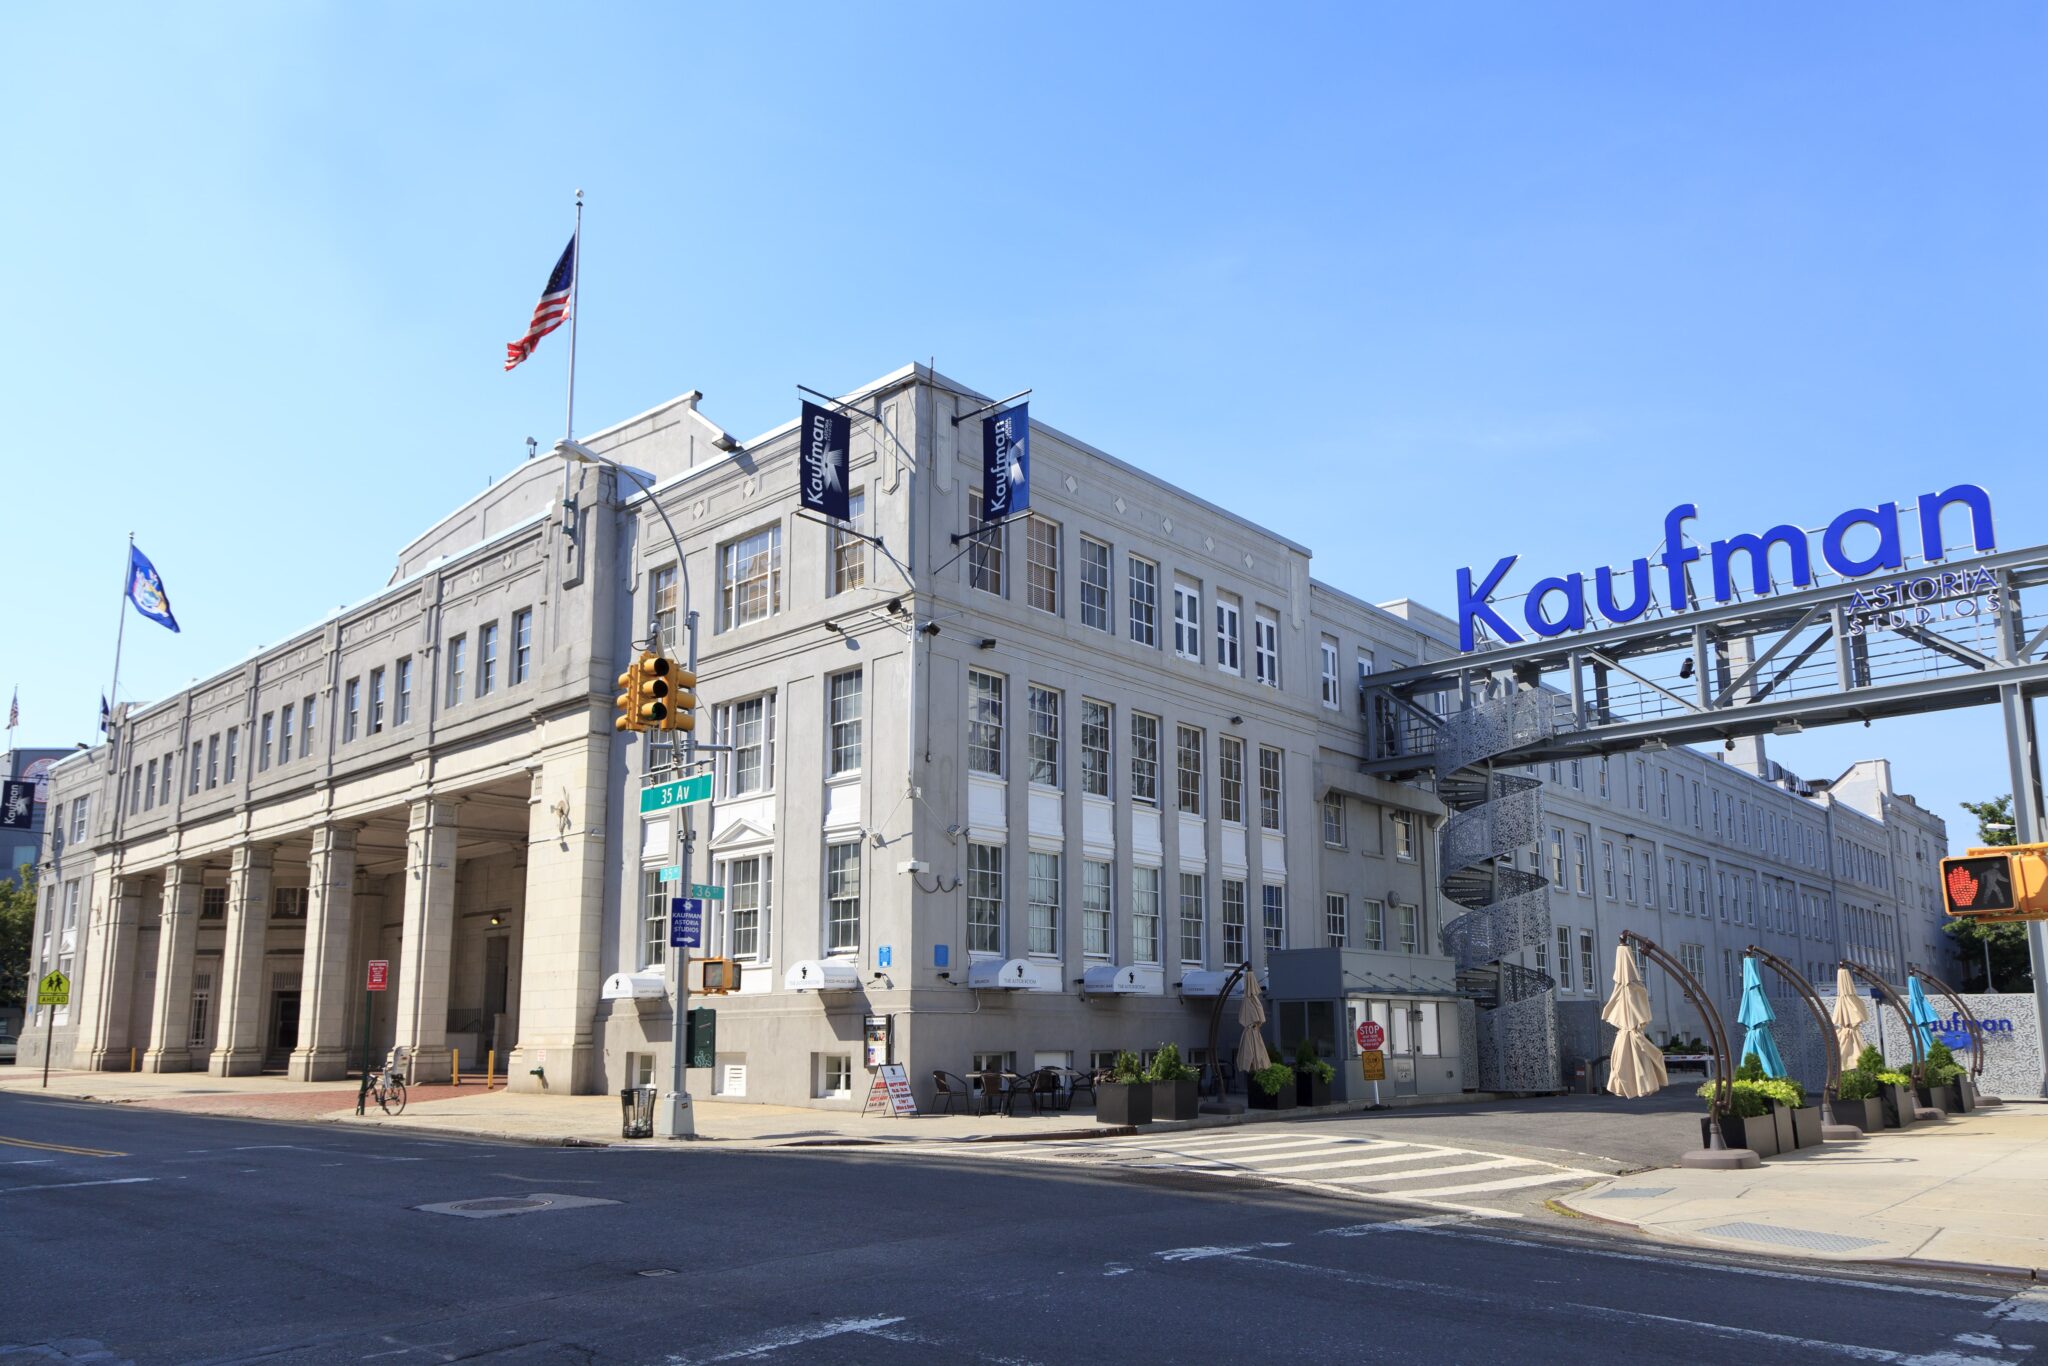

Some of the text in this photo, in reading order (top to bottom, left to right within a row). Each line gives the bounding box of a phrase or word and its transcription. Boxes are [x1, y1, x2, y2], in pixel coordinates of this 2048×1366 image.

[806, 415, 826, 504] Kaufman
[991, 420, 1006, 512] Kaufman
[1457, 484, 1997, 652] Kaufman
[1848, 565, 2000, 615] ASTORIA
[1850, 594, 2001, 636] STUDIOS
[4, 784, 19, 824] Kaufman
[660, 785, 690, 805] 35 Av
[663, 868, 673, 880] 35
[696, 886, 712, 898] 36
[1360, 1025, 1380, 1035] STOP
[1928, 1012, 2013, 1032] aufman
